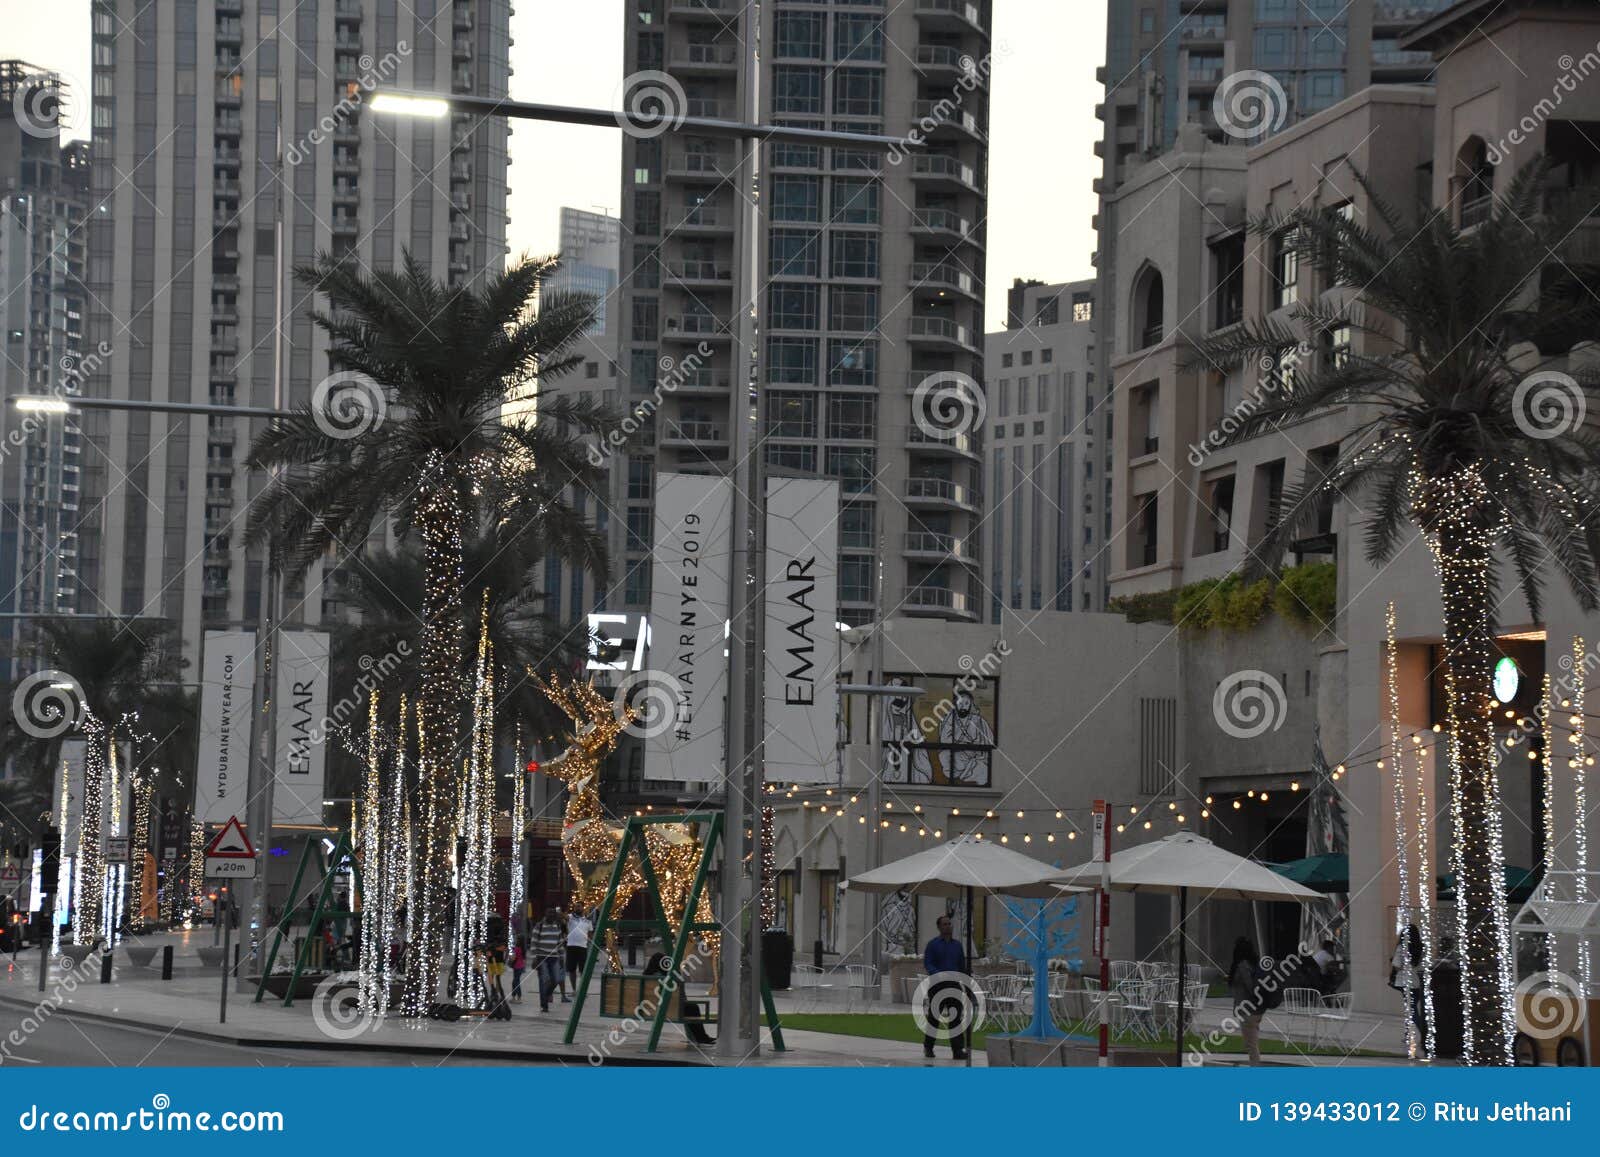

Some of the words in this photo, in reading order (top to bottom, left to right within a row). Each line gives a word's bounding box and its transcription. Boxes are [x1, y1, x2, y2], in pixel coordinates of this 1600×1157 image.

[785, 556, 815, 706] EMAAR
[217, 655, 234, 798] MYDUBAINEWYEAR.COM
[289, 680, 314, 775] EMAAR
